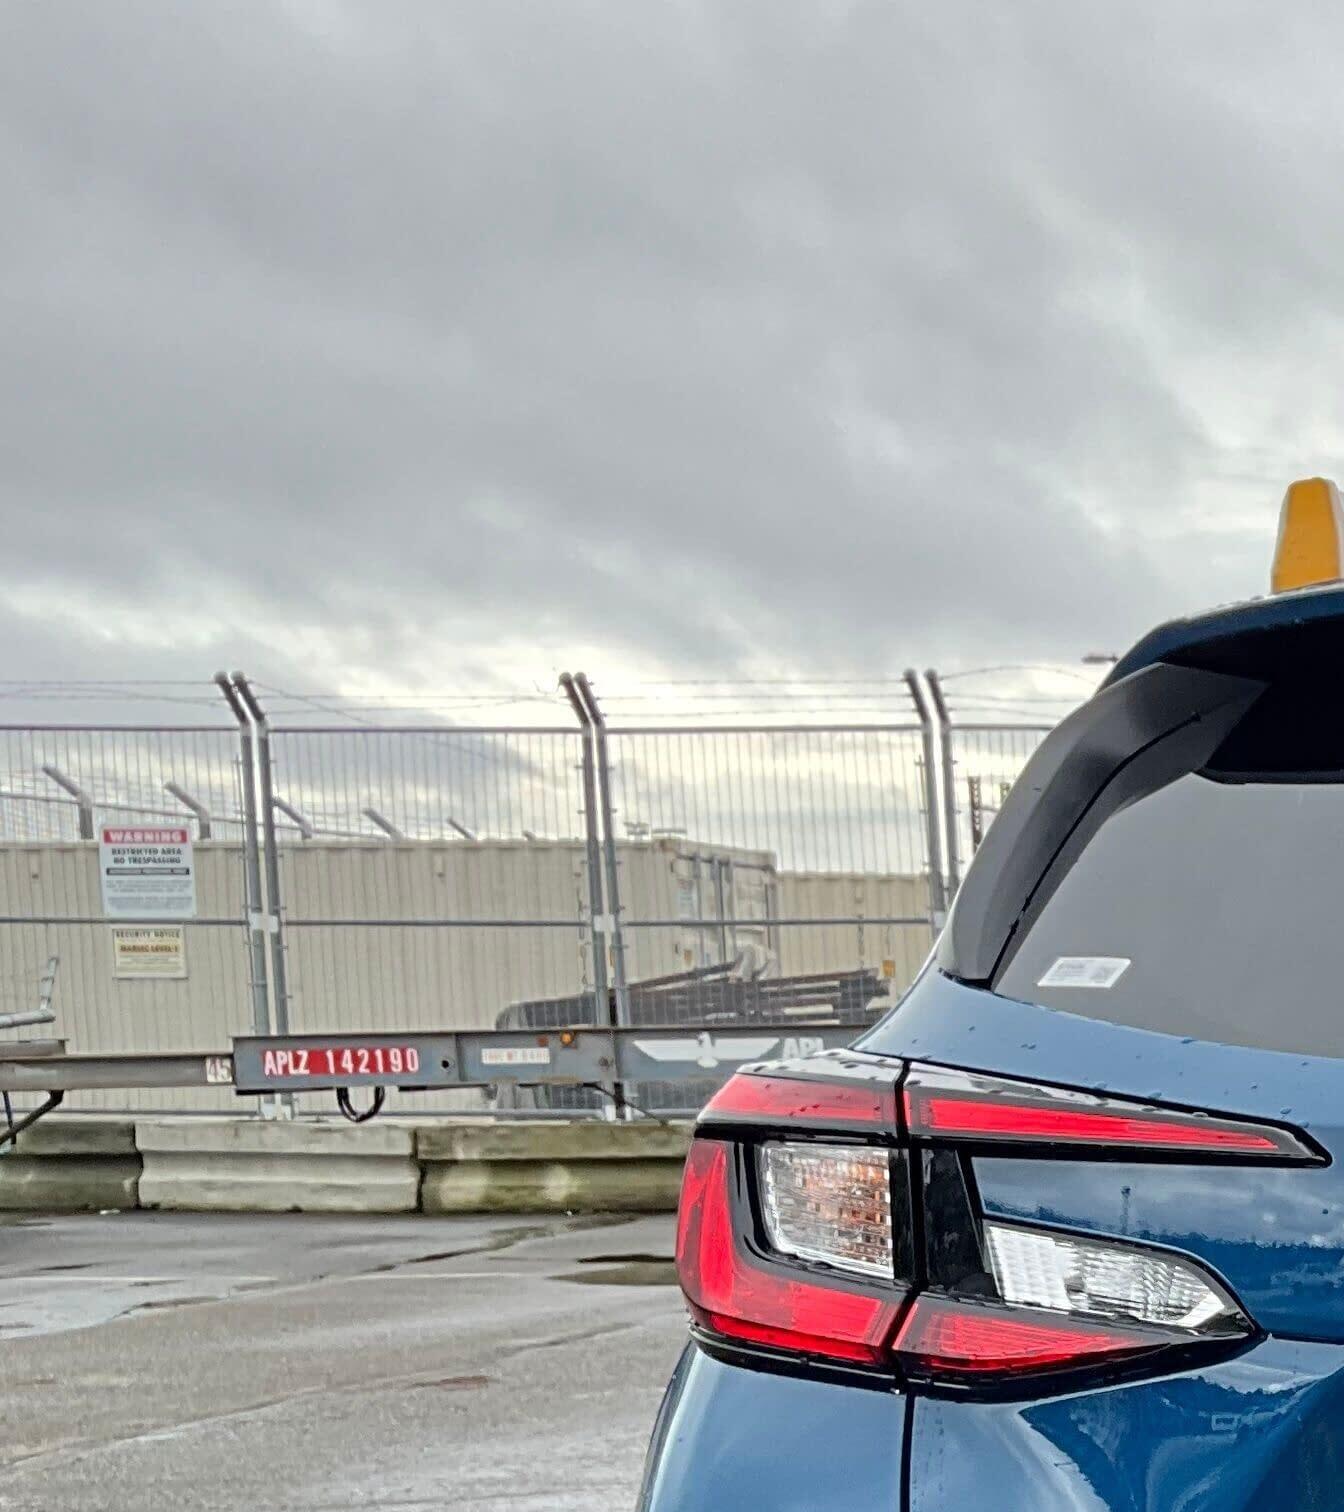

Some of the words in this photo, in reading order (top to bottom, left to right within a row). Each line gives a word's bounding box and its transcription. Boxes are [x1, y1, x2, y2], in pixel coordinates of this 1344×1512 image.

[109, 830, 182, 843] WARNING
[264, 1051, 310, 1076] APLZ
[326, 1048, 419, 1074] 142190
